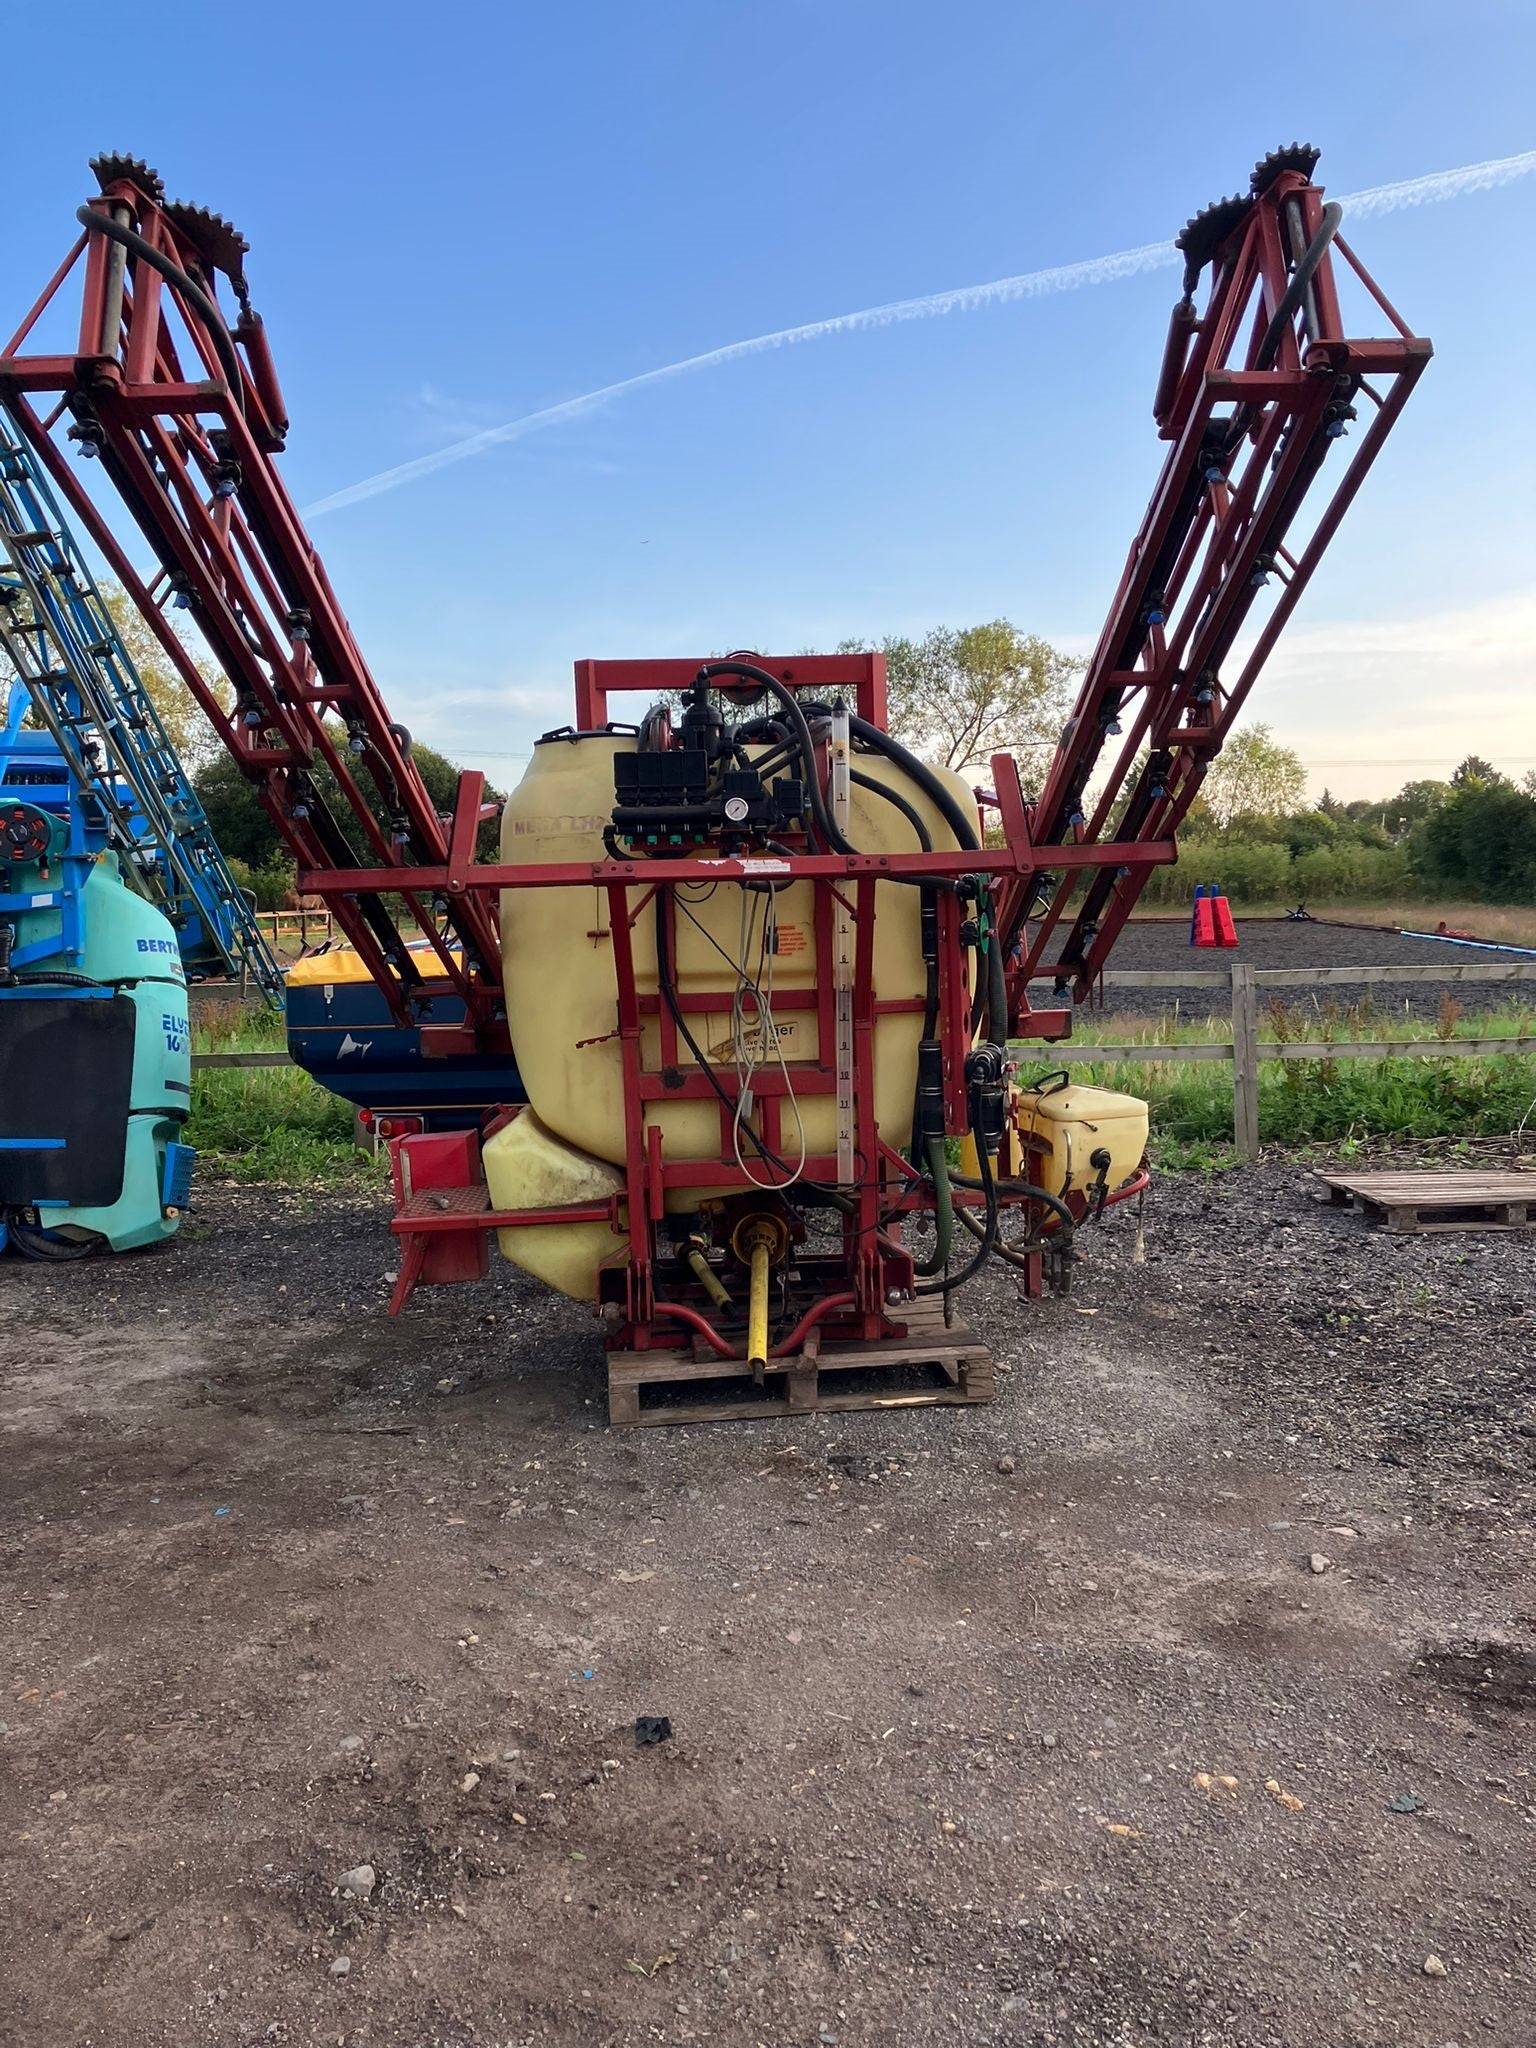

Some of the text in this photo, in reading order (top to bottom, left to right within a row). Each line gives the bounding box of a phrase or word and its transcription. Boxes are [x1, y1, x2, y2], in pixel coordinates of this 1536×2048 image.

[840, 1071, 849, 1079] 10
[840, 1100, 849, 1108] 11
[840, 1130, 849, 1138] 12
